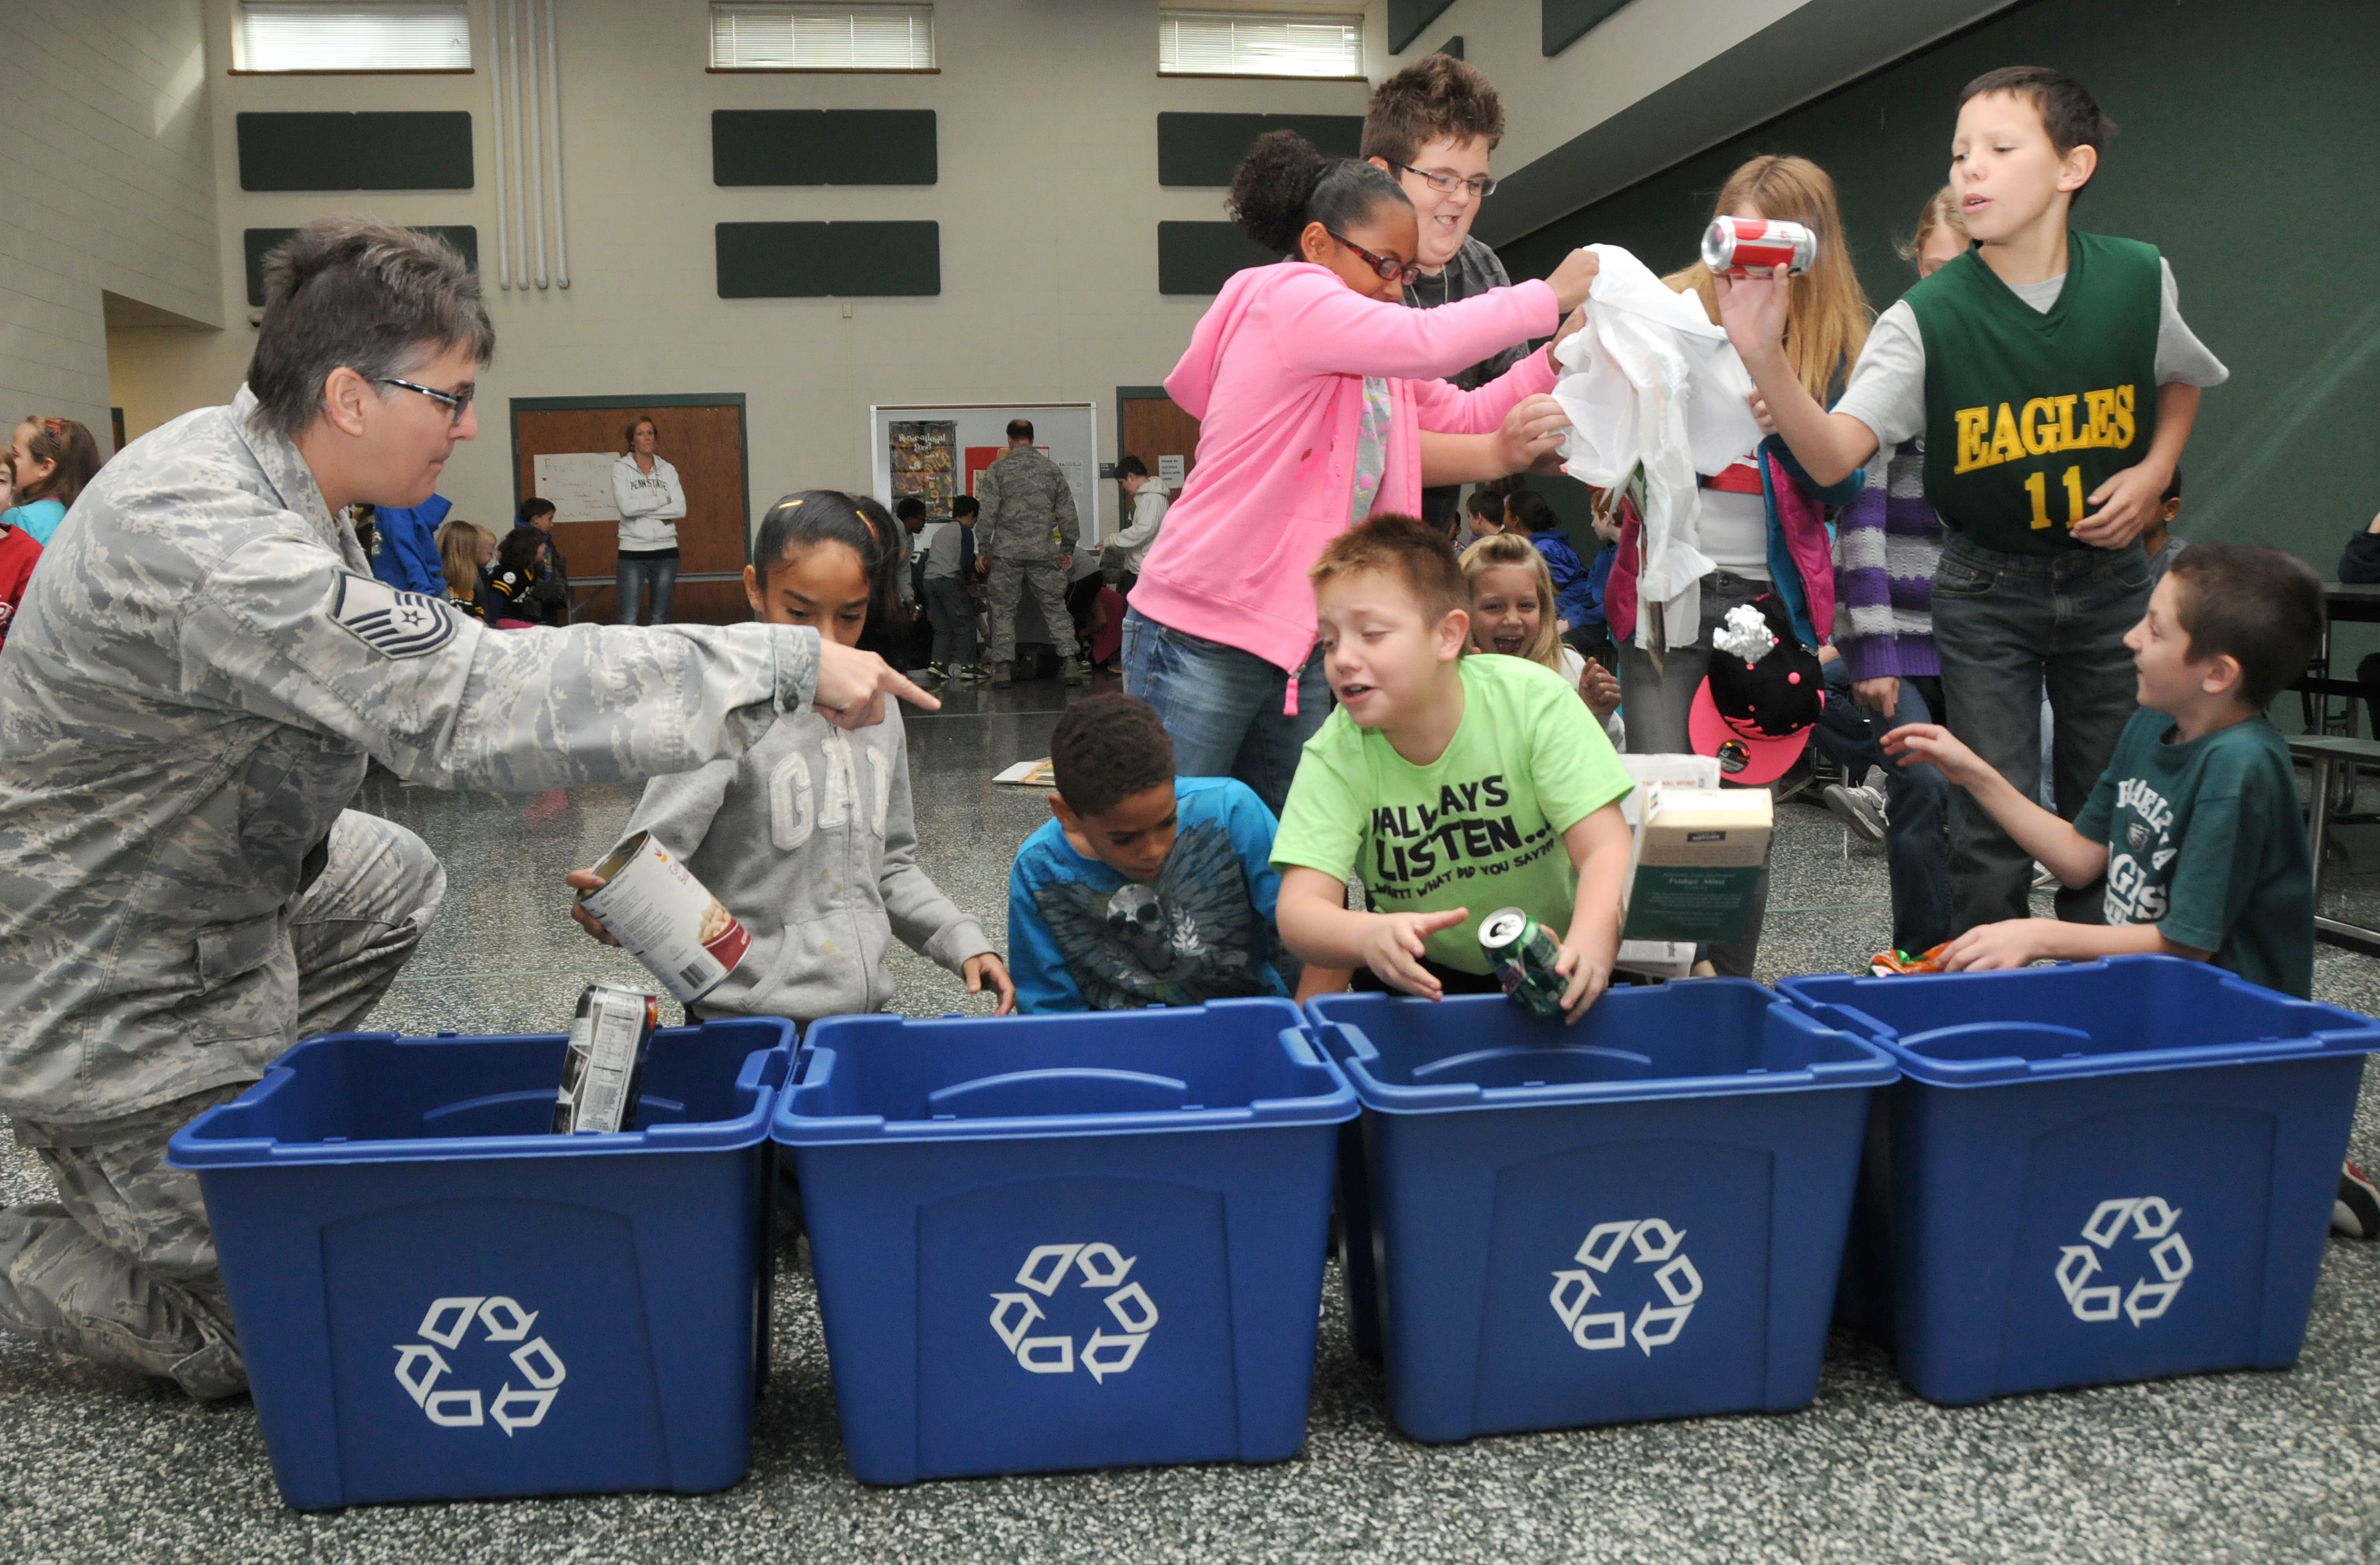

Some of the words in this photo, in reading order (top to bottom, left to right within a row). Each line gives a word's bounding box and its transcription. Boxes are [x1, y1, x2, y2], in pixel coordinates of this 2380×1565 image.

[914, 442, 931, 452] Food
[1954, 384, 2135, 474] EAGLES
[630, 478, 647, 490] PENN
[647, 478, 667, 491] STATE
[2024, 465, 2084, 530] 11
[1380, 775, 1509, 839] ALWAYS
[1416, 870, 1452, 897] WHAT
[1457, 865, 1475, 878] DID
[1480, 860, 1510, 875] YOU
